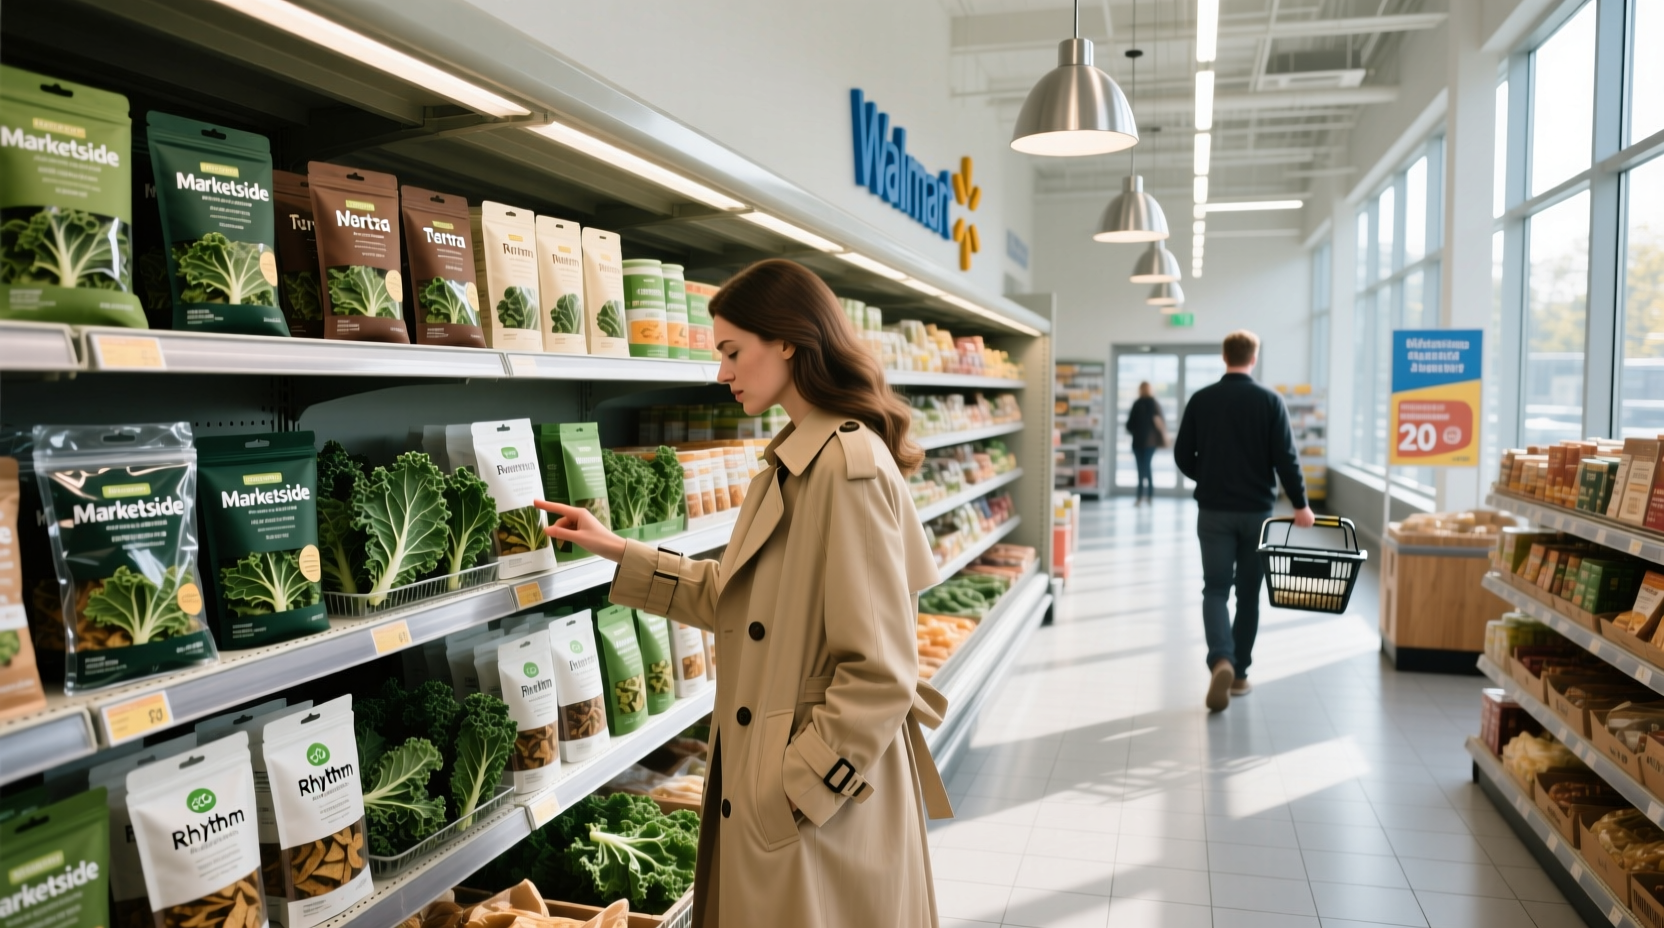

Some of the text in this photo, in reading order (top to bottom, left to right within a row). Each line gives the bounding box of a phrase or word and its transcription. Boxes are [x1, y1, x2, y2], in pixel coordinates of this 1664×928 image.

[0, 126, 120, 168] Marketside
[850, 88, 954, 241] Walmart
[176, 171, 270, 202] Marketside
[1398, 423, 1437, 452] 20
[73, 496, 184, 526] Marketside
[221, 484, 311, 510] Marketside
[298, 763, 354, 797] Rhythm
[172, 809, 245, 851] Rhythm
[0, 860, 99, 918] arketside
